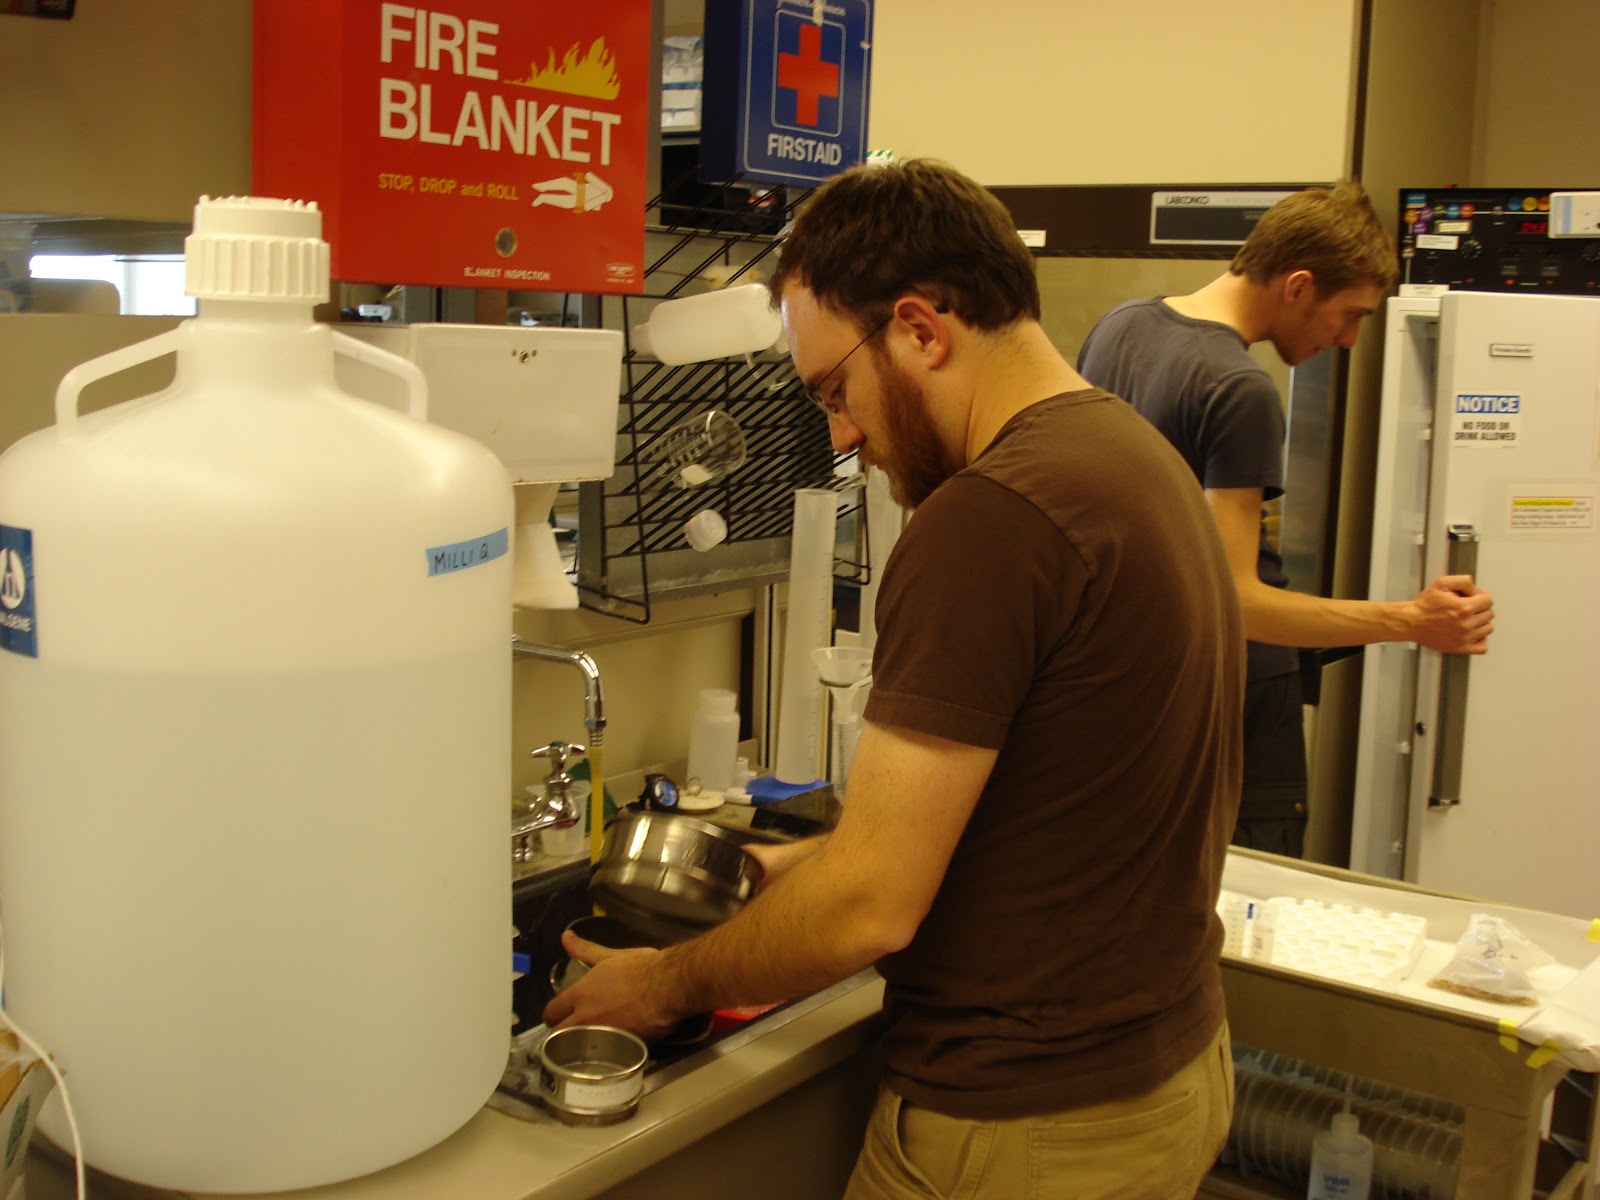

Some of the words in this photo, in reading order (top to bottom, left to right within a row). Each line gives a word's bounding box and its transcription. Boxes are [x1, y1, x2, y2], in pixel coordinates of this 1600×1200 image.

[380, 2, 500, 81] FIRE
[379, 77, 622, 166] BLANKET
[378, 173, 415, 193] STOP,
[419, 176, 457, 194] DROP
[460, 182, 483, 197] and
[487, 183, 519, 201] ROLL
[464, 266, 501, 278] BLANKET
[504, 269, 550, 281] INSPECTION
[1457, 396, 1519, 413] NOTICE
[1462, 421, 1474, 430] NO
[1476, 421, 1496, 430] FOOD
[1499, 421, 1510, 430] OR
[1455, 432, 1478, 441] DRINK
[1481, 432, 1516, 441] ALLOWED
[434, 548, 474, 574] MILLI
